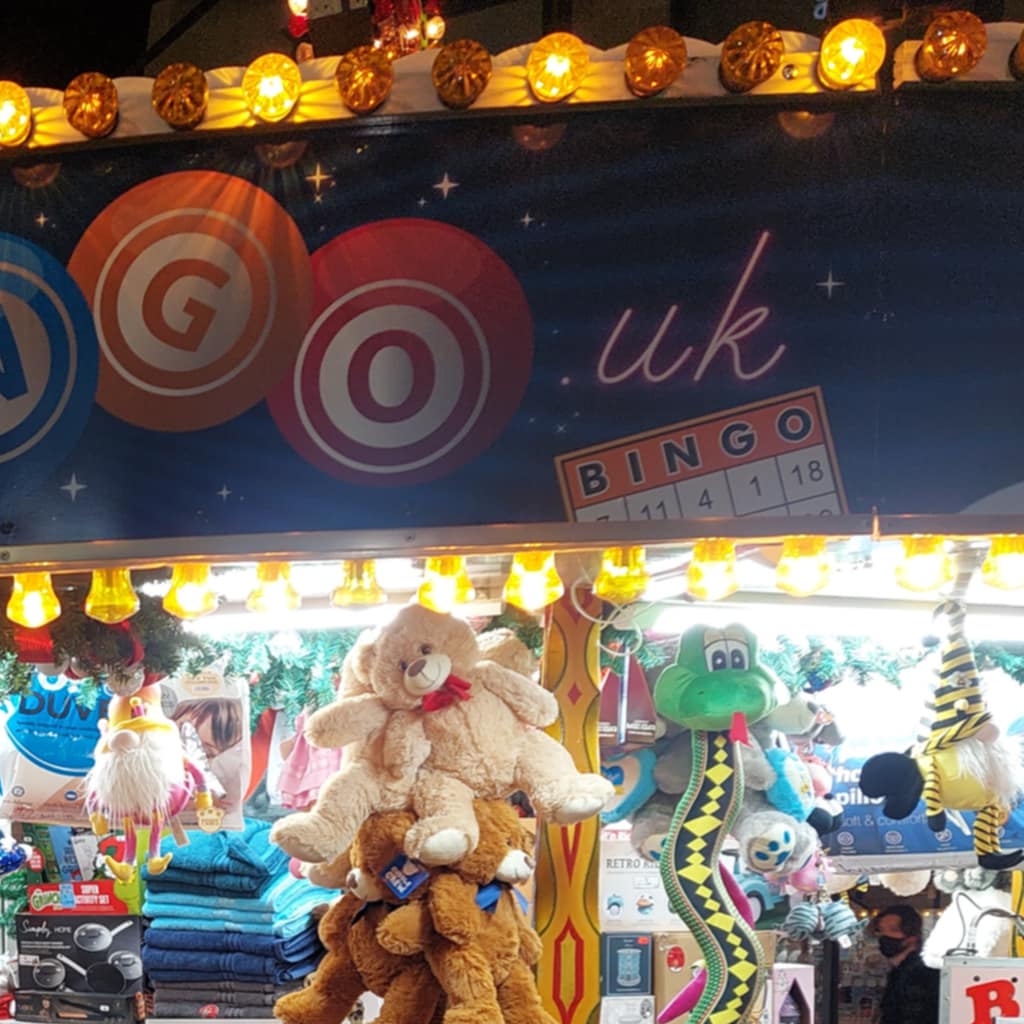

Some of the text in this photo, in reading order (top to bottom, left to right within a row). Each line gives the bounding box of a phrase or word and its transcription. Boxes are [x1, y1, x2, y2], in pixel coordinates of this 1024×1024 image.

[577, 406, 813, 497] BINGO
[698, 489, 713, 510] 4
[750, 476, 762, 497] 1
[791, 460, 825, 486] 18
[19, 690, 108, 720] DUVE
[606, 858, 640, 870] RETRO
